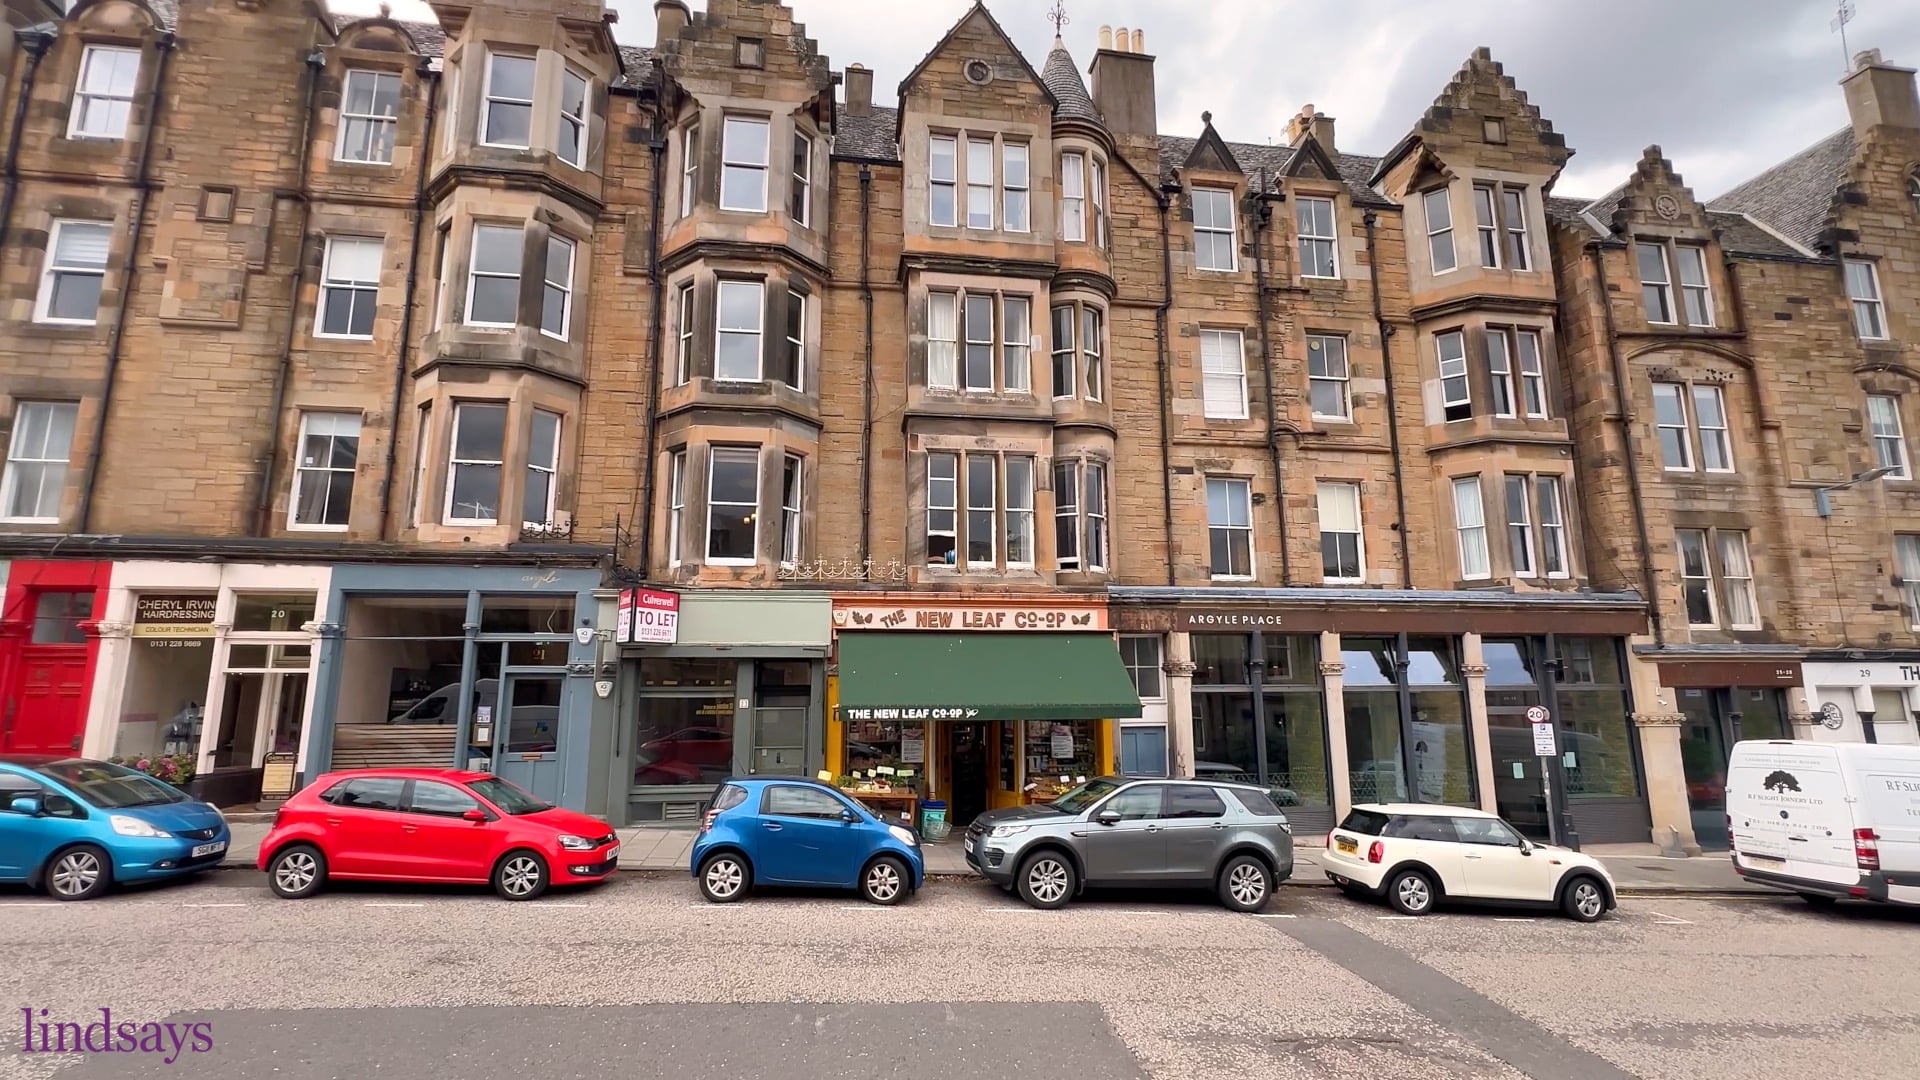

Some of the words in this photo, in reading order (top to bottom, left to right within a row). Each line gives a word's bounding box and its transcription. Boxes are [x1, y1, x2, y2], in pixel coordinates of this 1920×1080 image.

[138, 599, 183, 610] CHERYL
[186, 599, 216, 610] IRVIN
[642, 593, 674, 607] Culverwell
[142, 610, 215, 619] HAIRDRESSING
[271, 609, 285, 618] 20
[638, 610, 654, 625] TO
[657, 612, 676, 627] LET
[880, 609, 907, 629] THE
[916, 611, 953, 628] NEW
[962, 611, 1006, 628] LEAF
[1014, 611, 1066, 628] CO-OP
[1188, 615, 1238, 624] ARGYLE
[1242, 615, 1282, 625] PLACE
[150, 640, 168, 648] 0131
[1860, 669, 1871, 678] 29
[848, 709, 872, 719] THE
[873, 709, 899, 719] NEW
[901, 708, 930, 719] LEAF
[932, 708, 963, 719] CO-OP
[1529, 710, 1542, 719] 20
[1885, 780, 1895, 791] R
[1895, 780, 1901, 791] F
[1780, 795, 1807, 804] JOINERY
